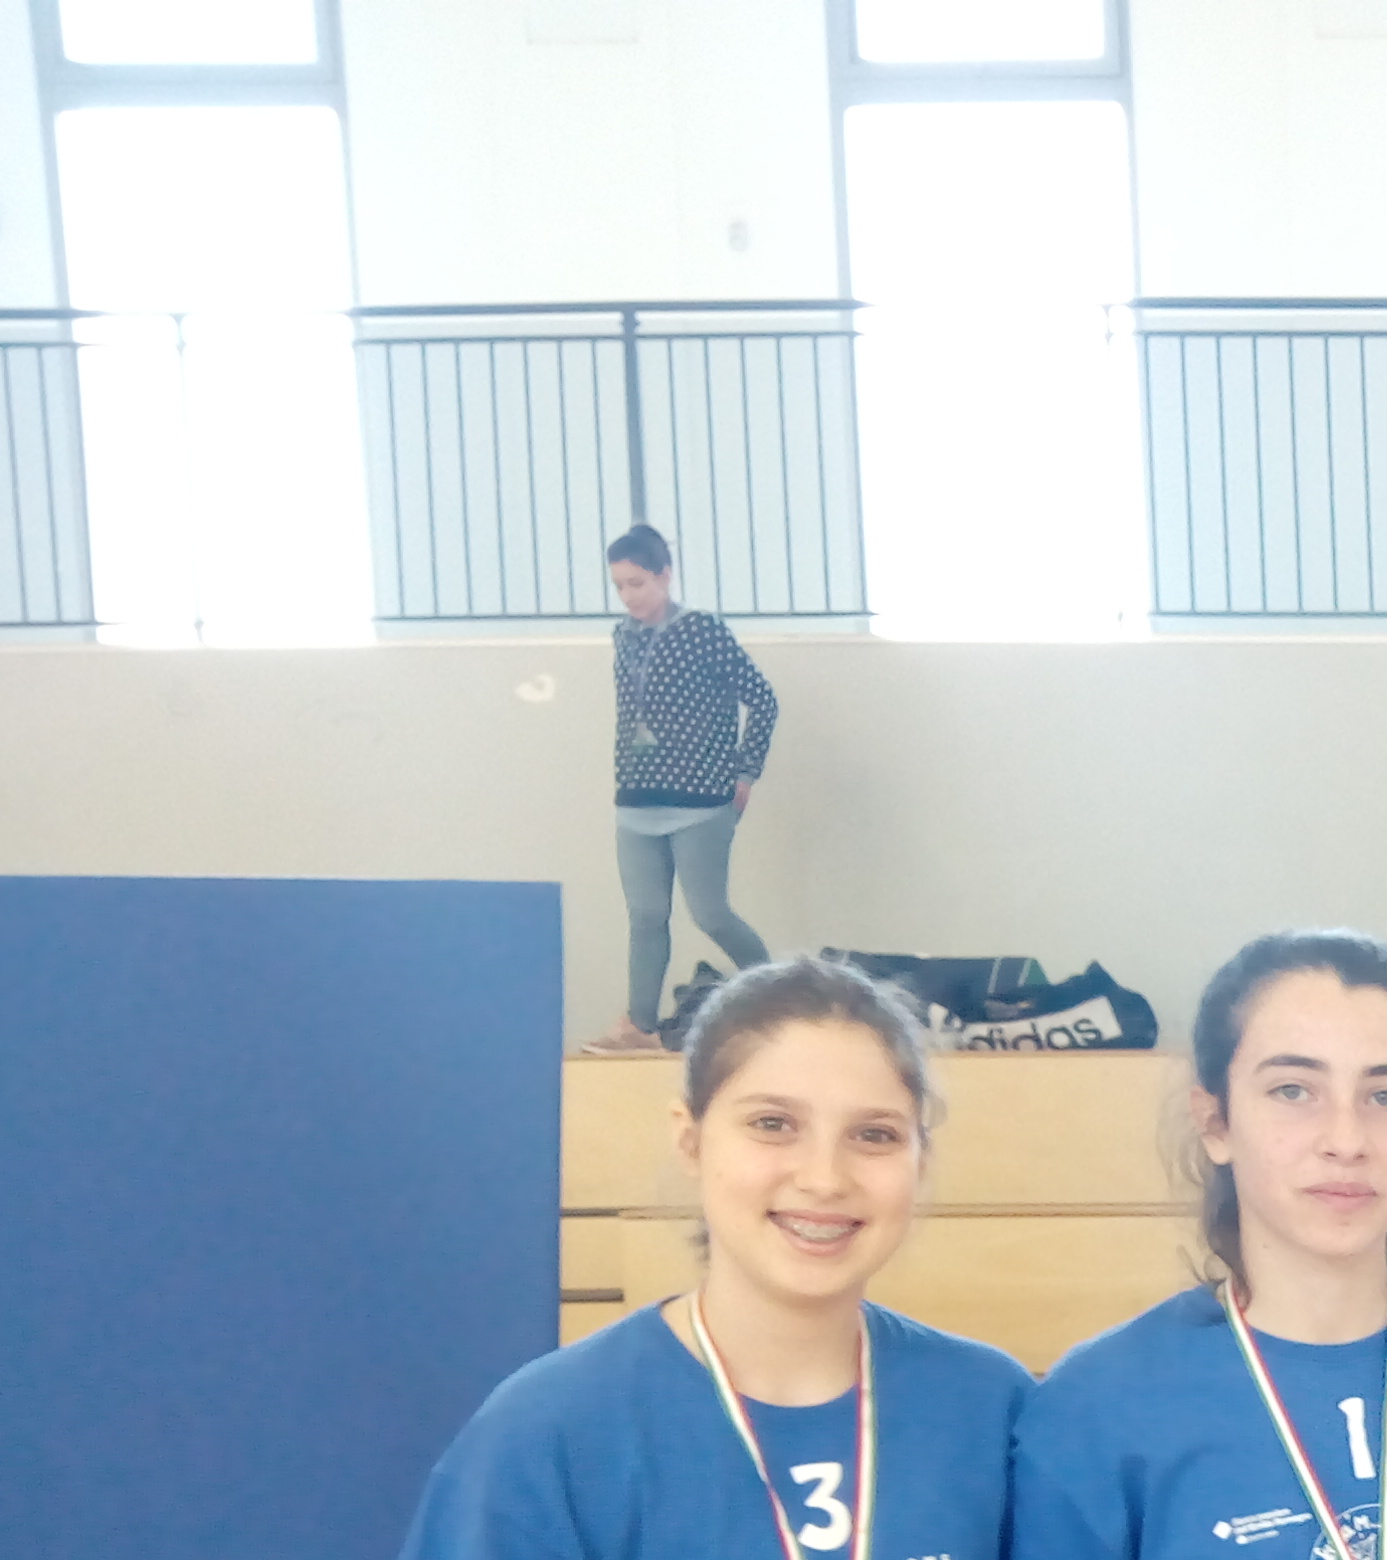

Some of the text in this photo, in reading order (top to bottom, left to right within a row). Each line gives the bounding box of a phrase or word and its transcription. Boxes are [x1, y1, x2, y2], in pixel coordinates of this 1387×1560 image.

[958, 1017, 1103, 1051] didas
[1338, 1397, 1376, 1479] 1
[789, 1461, 852, 1550] 3
